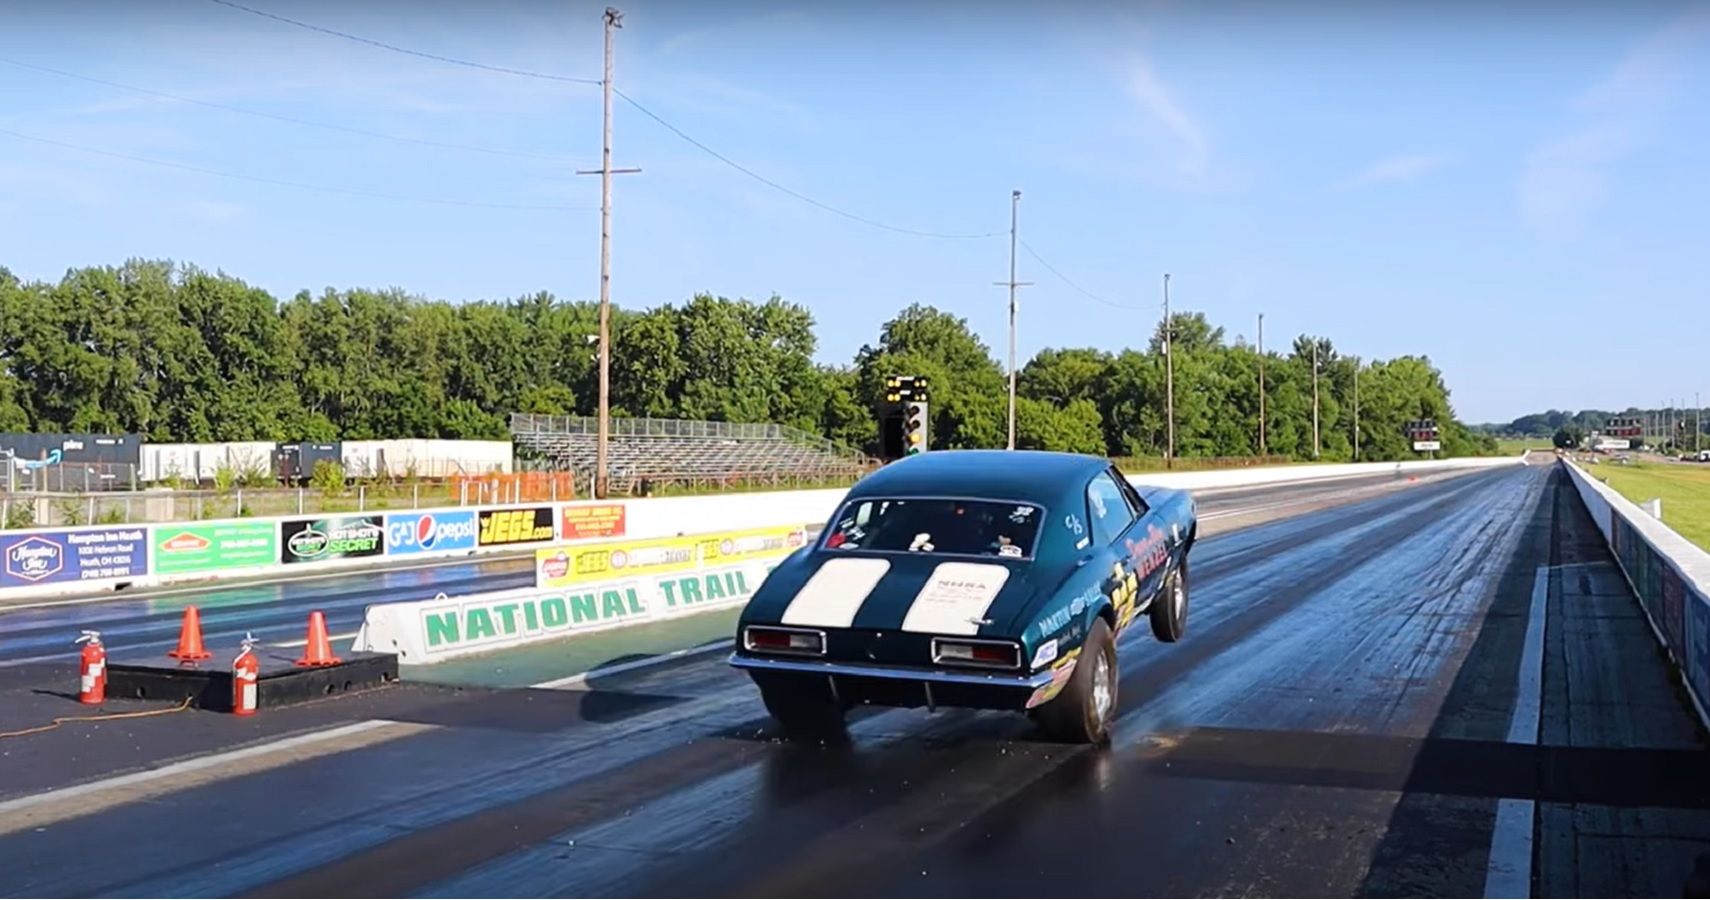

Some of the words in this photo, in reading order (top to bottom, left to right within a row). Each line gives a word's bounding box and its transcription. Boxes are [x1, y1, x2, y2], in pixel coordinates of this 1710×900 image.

[67, 534, 105, 545] Hampton
[104, 531, 119, 542] Inn
[118, 529, 143, 541] Heath
[437, 517, 474, 543] pepsi
[329, 538, 378, 553] SECRET
[425, 587, 646, 647] NATIONAL
[658, 570, 751, 607] TRAIL
